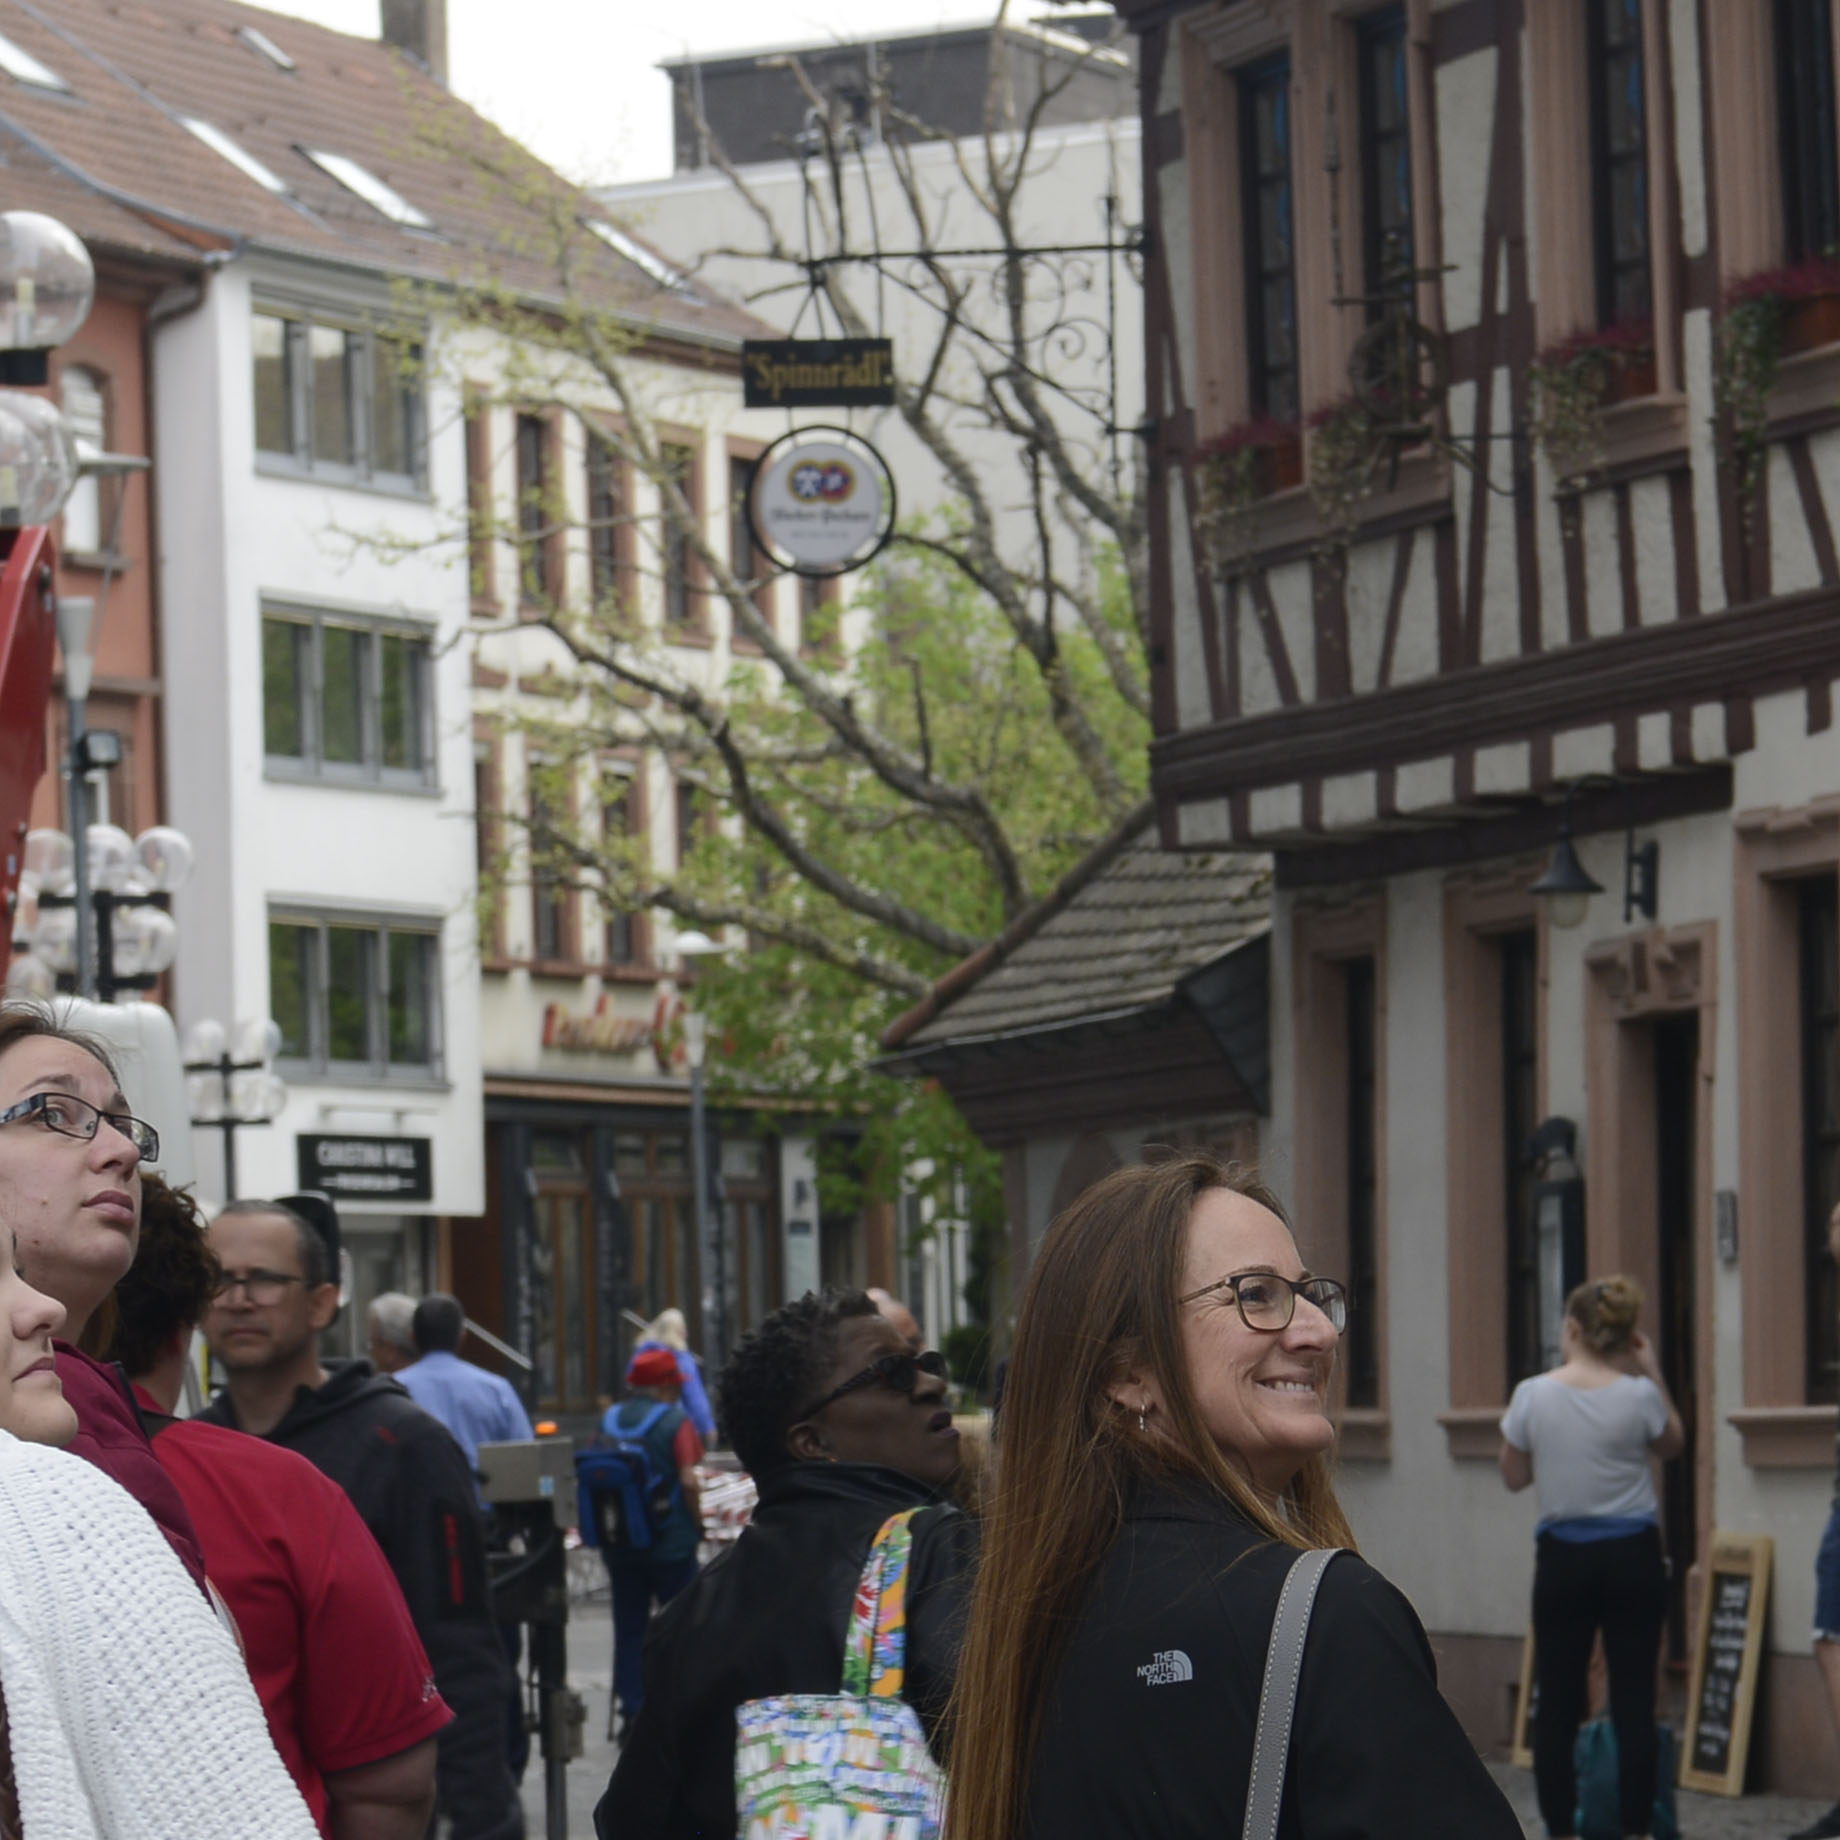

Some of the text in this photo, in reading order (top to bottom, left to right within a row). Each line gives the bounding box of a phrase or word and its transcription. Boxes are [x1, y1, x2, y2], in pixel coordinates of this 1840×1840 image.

[1153, 1649, 1174, 1664] THE
[1136, 1660, 1174, 1678] NORTH
[1146, 1671, 1175, 1687] FACE
